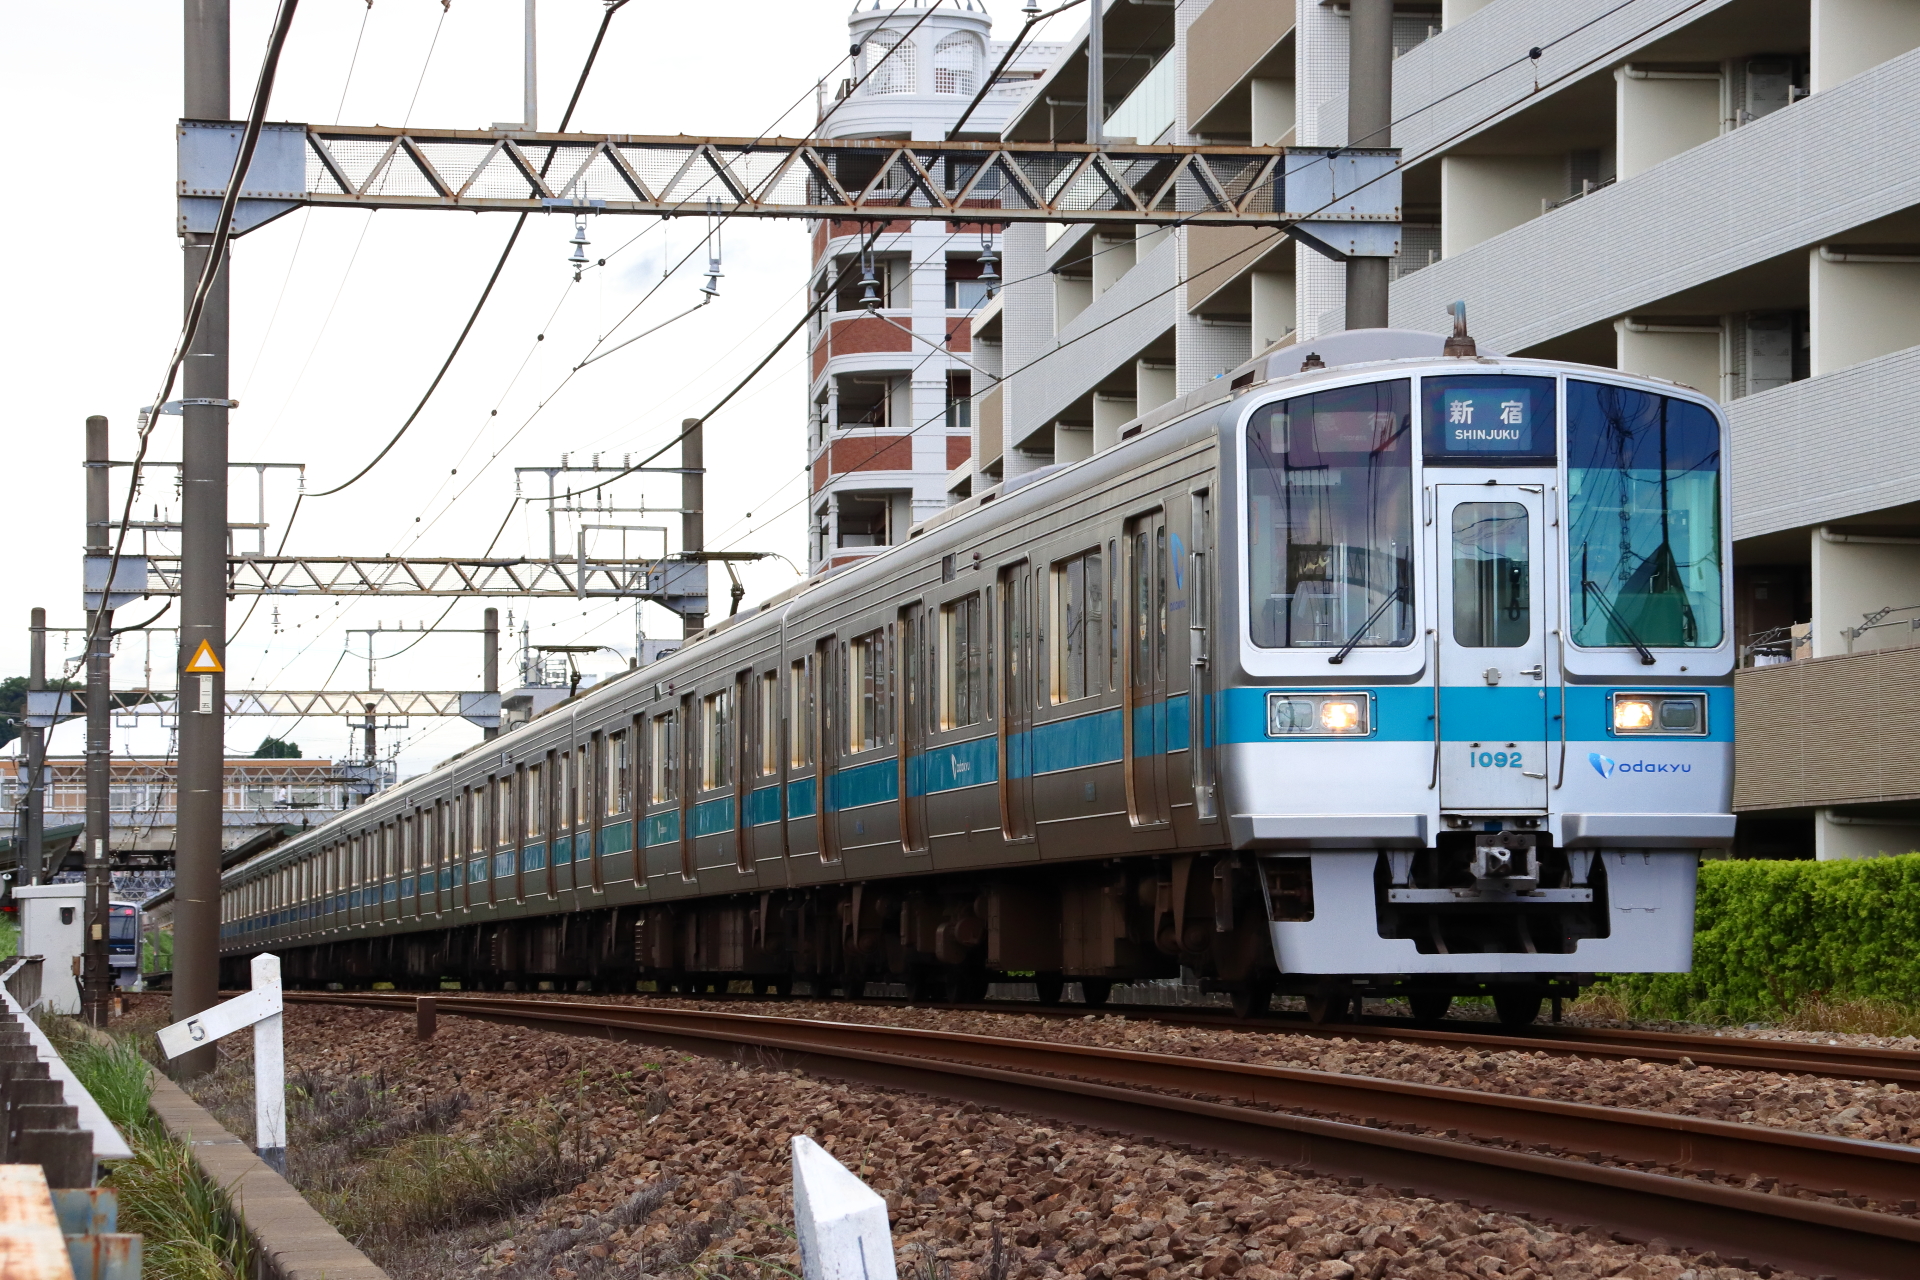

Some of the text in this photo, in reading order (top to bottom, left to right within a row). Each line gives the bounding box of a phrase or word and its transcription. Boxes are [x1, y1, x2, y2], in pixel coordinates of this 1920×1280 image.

[1449, 399, 1524, 424] 新宿
[1454, 429, 1520, 440] SHINJUKU
[1470, 751, 1523, 768] 1092
[1618, 759, 1691, 773] odakyu
[187, 1019, 205, 1041] 5
